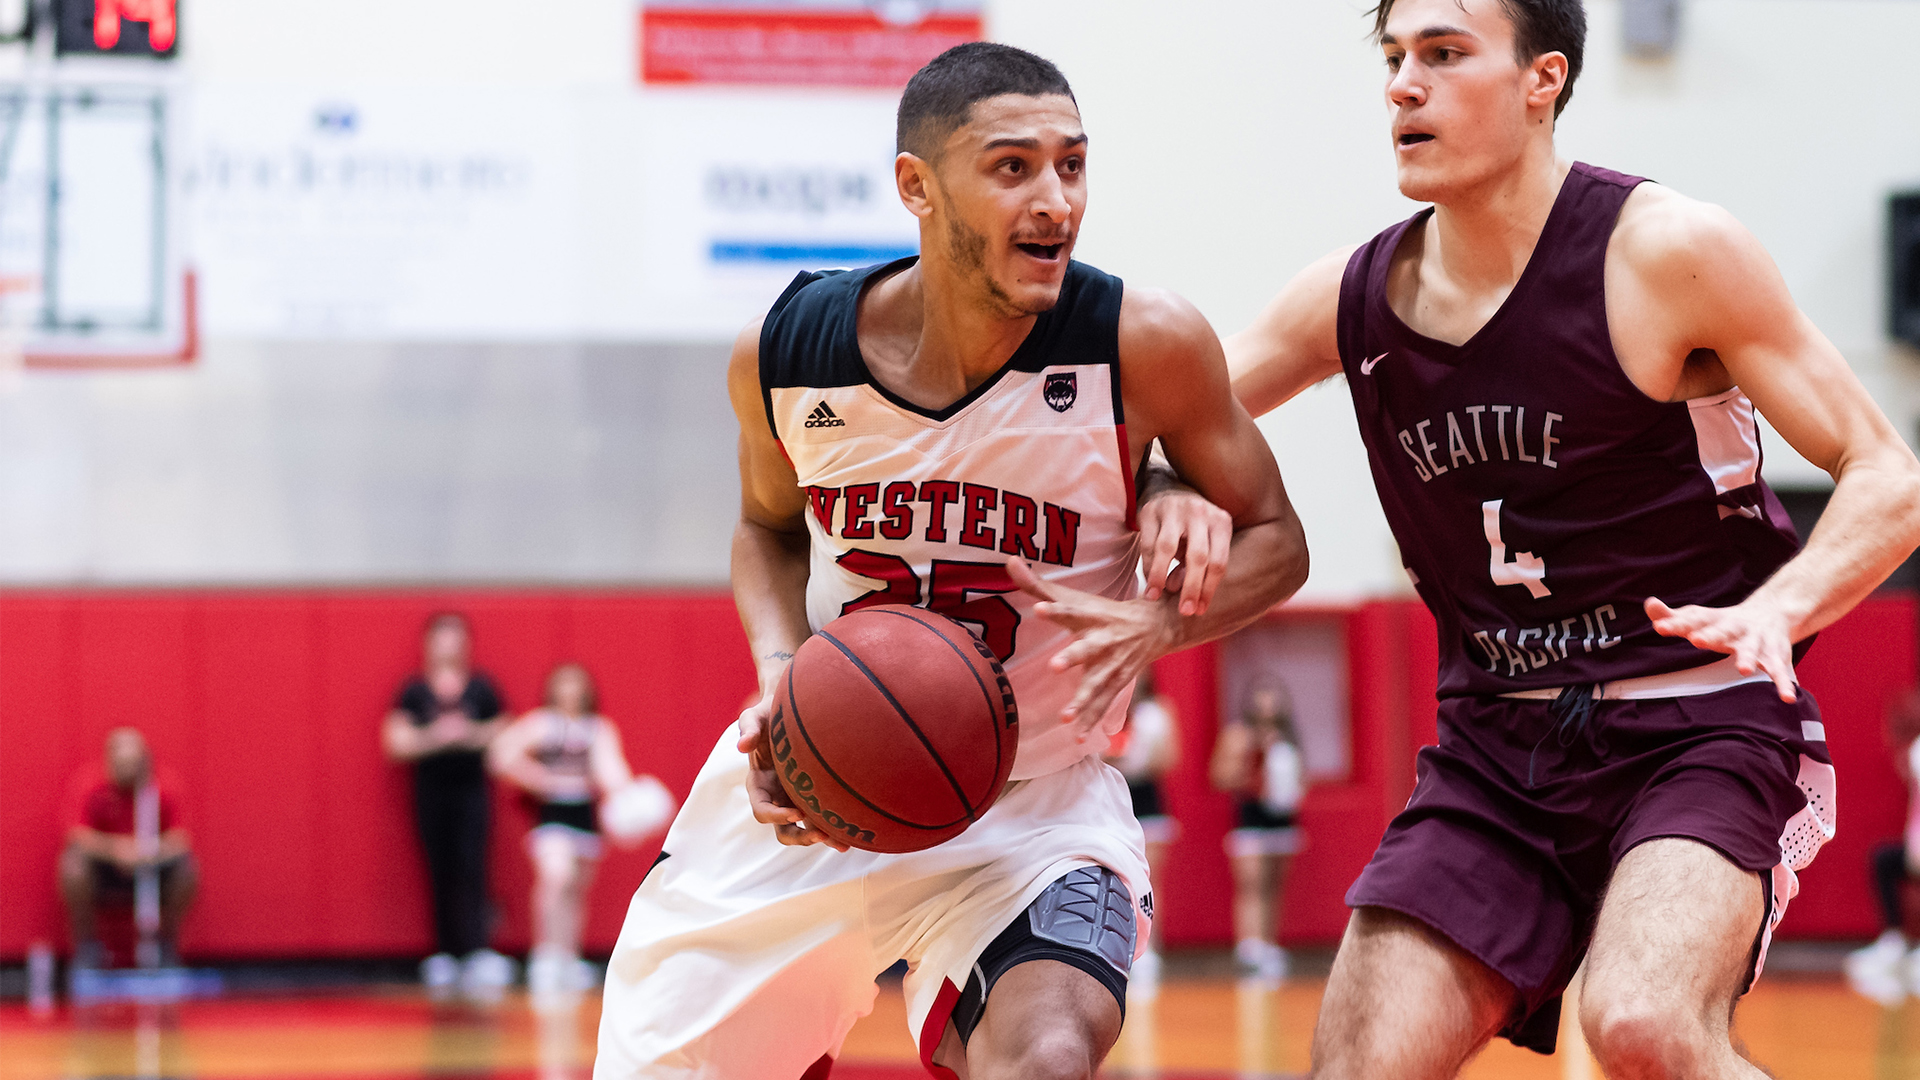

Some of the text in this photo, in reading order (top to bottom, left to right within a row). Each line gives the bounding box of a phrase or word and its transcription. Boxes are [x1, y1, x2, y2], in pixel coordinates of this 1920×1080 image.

[804, 417, 846, 428] adidas
[1398, 404, 1563, 483] SEATTLE
[804, 480, 1081, 568] WESTERN
[1481, 499, 1552, 599] 4
[1473, 603, 1622, 677] PACIFIC
[771, 703, 876, 844] Wilson
